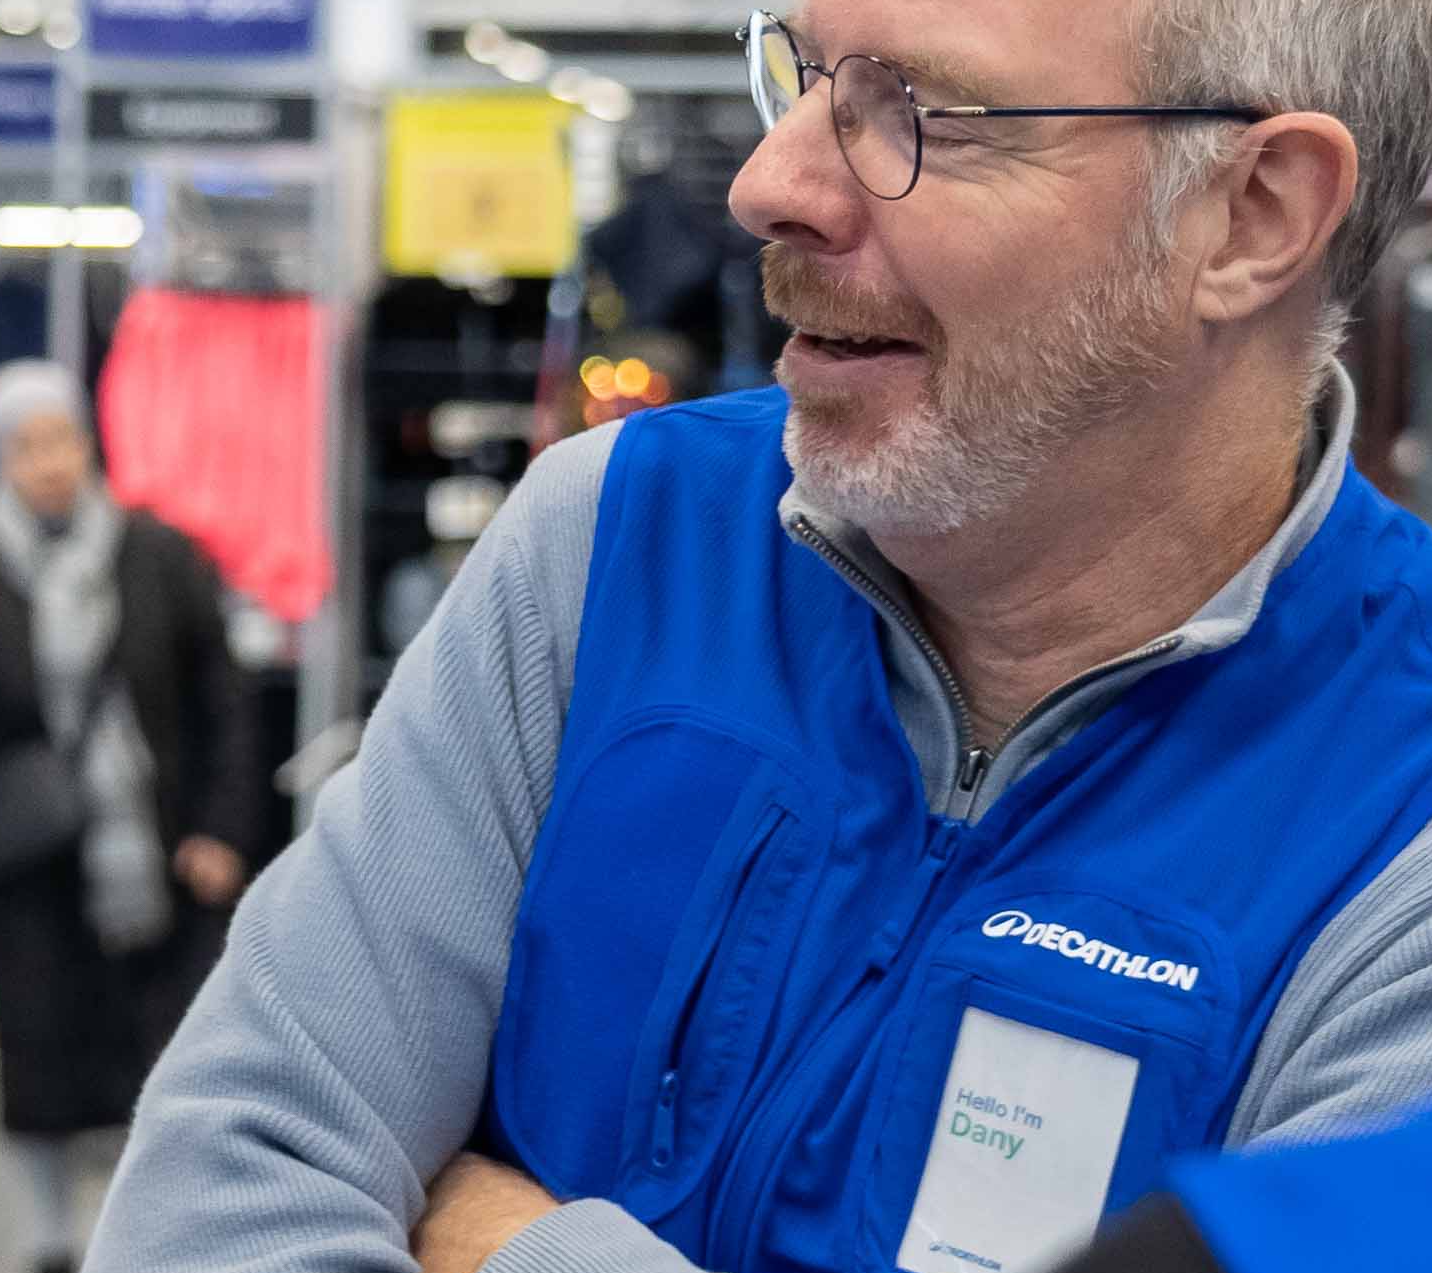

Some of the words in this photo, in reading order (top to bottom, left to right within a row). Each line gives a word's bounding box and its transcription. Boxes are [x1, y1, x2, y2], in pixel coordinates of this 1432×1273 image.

[1022, 923, 1200, 992] DECATHLON
[956, 1088, 1008, 1118] Hello
[1012, 1105, 1043, 1130] I'm
[950, 1111, 1025, 1161] Dany
